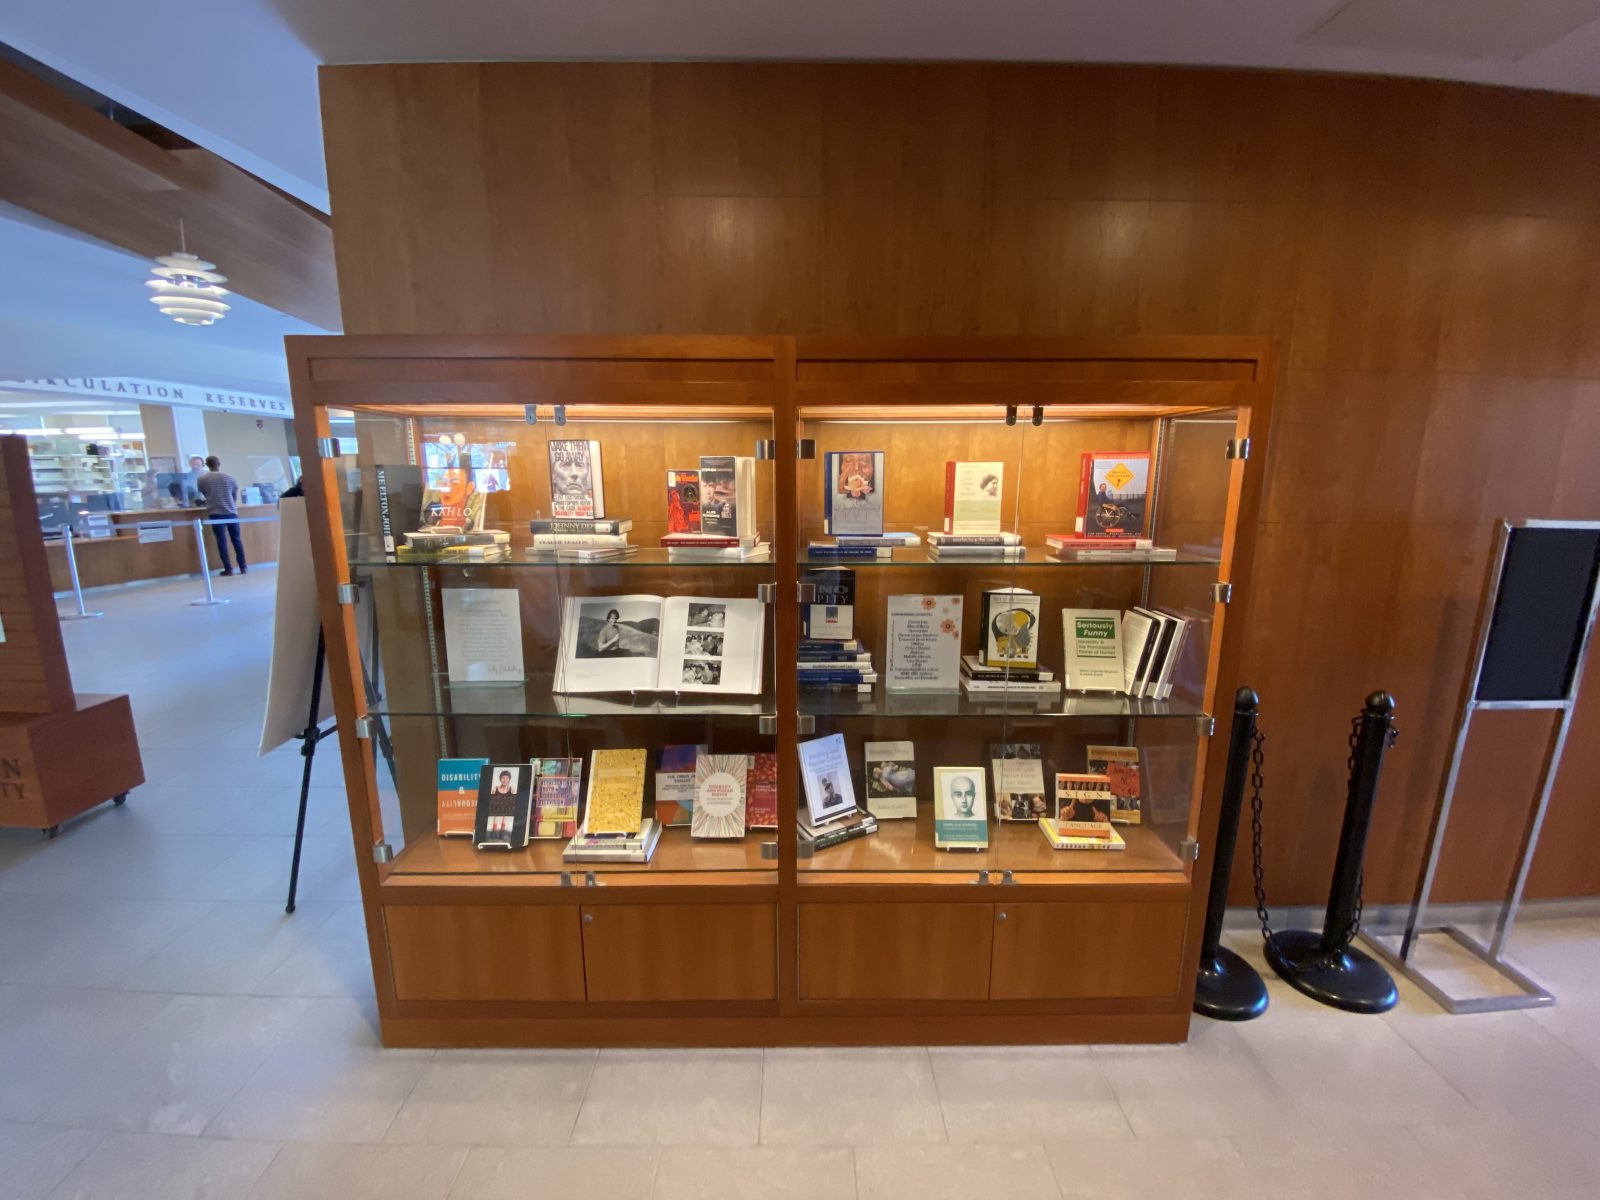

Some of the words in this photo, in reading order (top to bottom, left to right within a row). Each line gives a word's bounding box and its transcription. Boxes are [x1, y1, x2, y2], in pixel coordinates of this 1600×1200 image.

[15, 377, 185, 400] RCULATION
[205, 392, 287, 411] RESERVES
[431, 507, 472, 517] KAHLO
[382, 515, 391, 536] JOH
[817, 594, 849, 604] PITY
[1076, 621, 1113, 630] Seriously
[1083, 629, 1108, 637] Funny
[1065, 791, 1103, 799] SIGN
